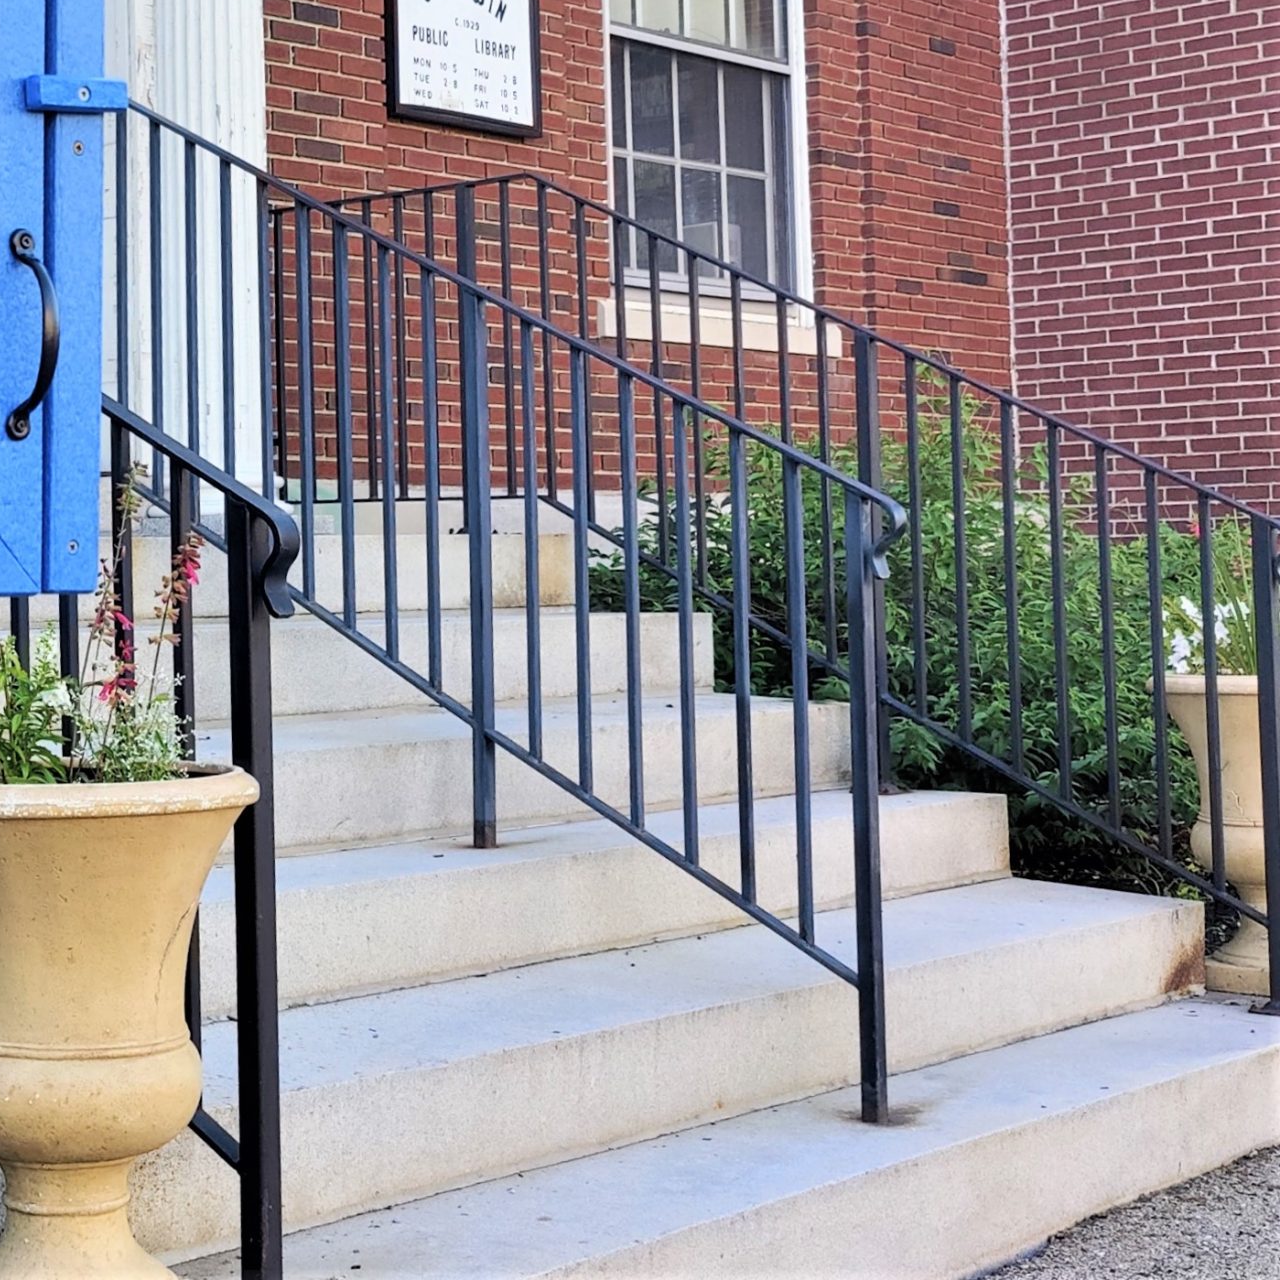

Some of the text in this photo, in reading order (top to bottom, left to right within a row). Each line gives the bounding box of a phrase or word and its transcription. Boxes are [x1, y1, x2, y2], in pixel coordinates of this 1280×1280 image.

[412, 25, 516, 60] PUBLIC LIBRARY
[413, 56, 431, 68] MON
[414, 72, 430, 84] TUE
[474, 68, 489, 80] THU
[414, 88, 433, 100] WED
[474, 84, 487, 94] FRI
[475, 98, 489, 109] SAT
